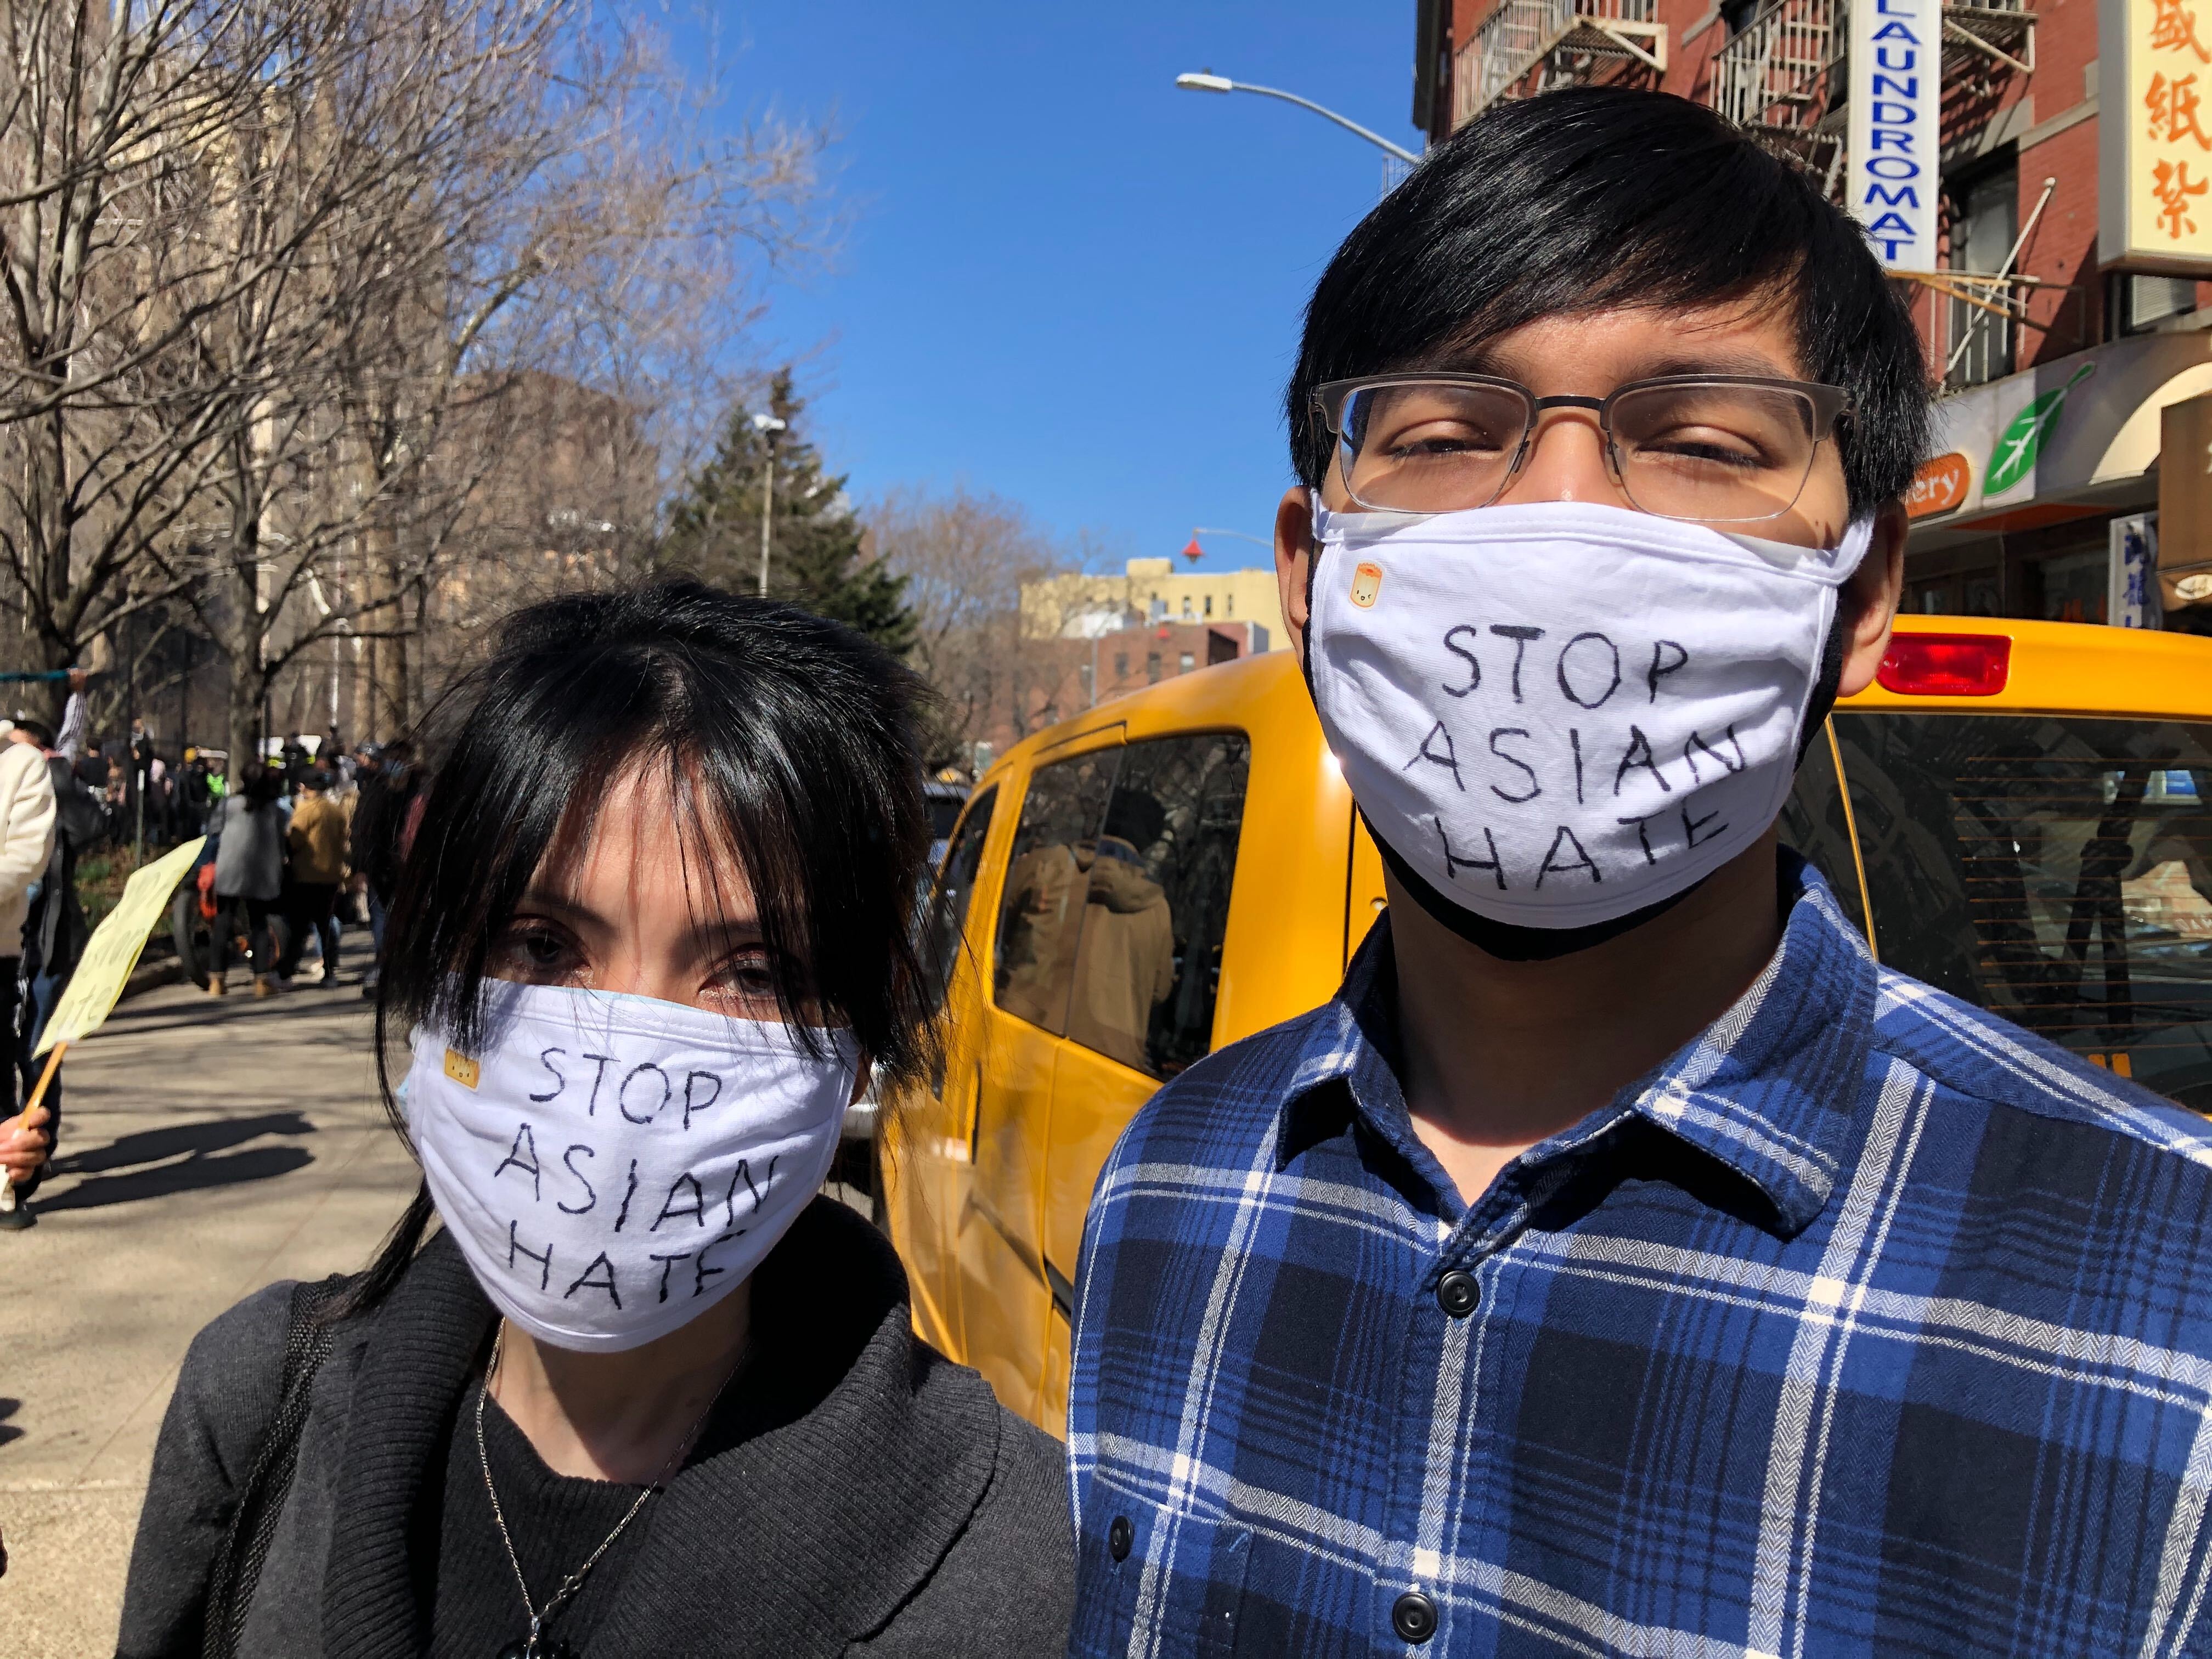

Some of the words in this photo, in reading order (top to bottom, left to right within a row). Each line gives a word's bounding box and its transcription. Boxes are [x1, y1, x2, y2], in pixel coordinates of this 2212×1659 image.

[1865, 0, 1922, 261] LAUNDROMAT
[1905, 469, 1960, 505] ery
[1442, 624, 1689, 709] STOP
[1402, 720, 1747, 804] ASIAN
[1434, 797, 1729, 890] HATE
[529, 1047, 723, 1130] STOP
[494, 1122, 779, 1233] ASIAN
[509, 1220, 746, 1310] HATE
